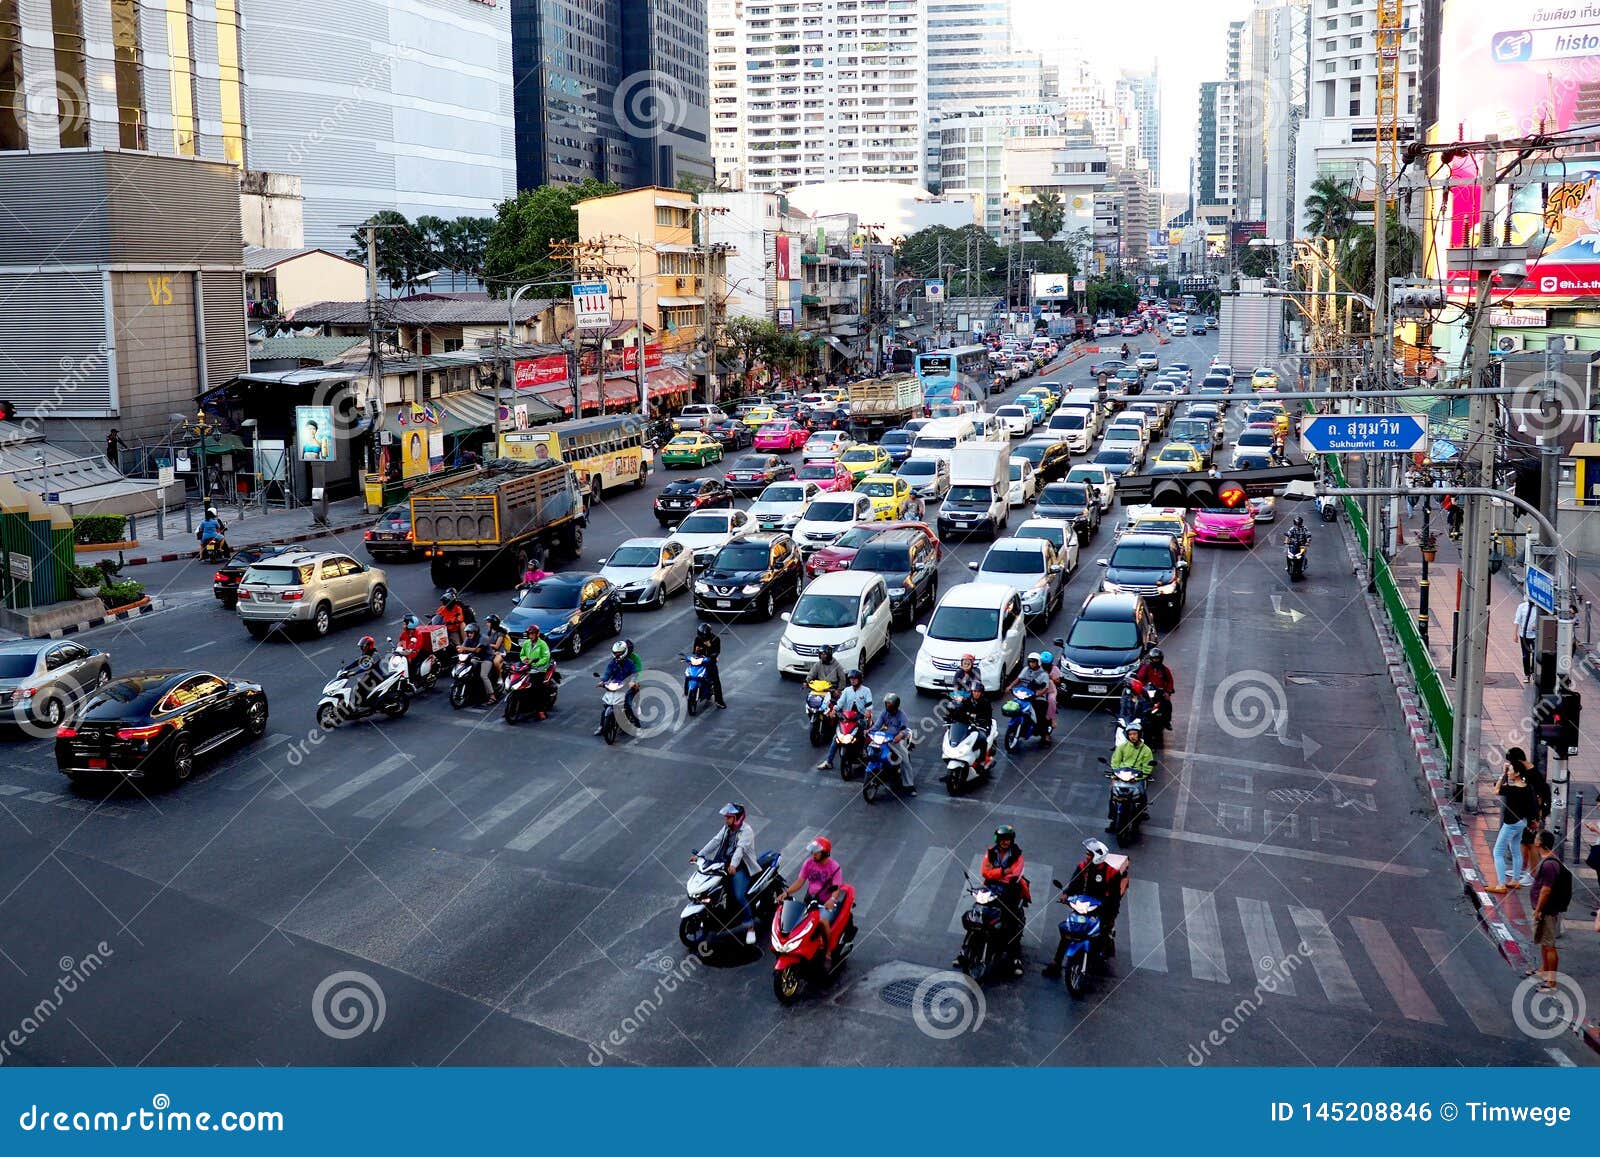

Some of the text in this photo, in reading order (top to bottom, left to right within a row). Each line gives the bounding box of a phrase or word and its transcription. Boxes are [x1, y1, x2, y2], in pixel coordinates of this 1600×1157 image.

[147, 275, 173, 305] VS
[1328, 419, 1400, 440] ถ. สุขุมวิท
[1329, 440, 1399, 448] Sukhumvit Rd.
